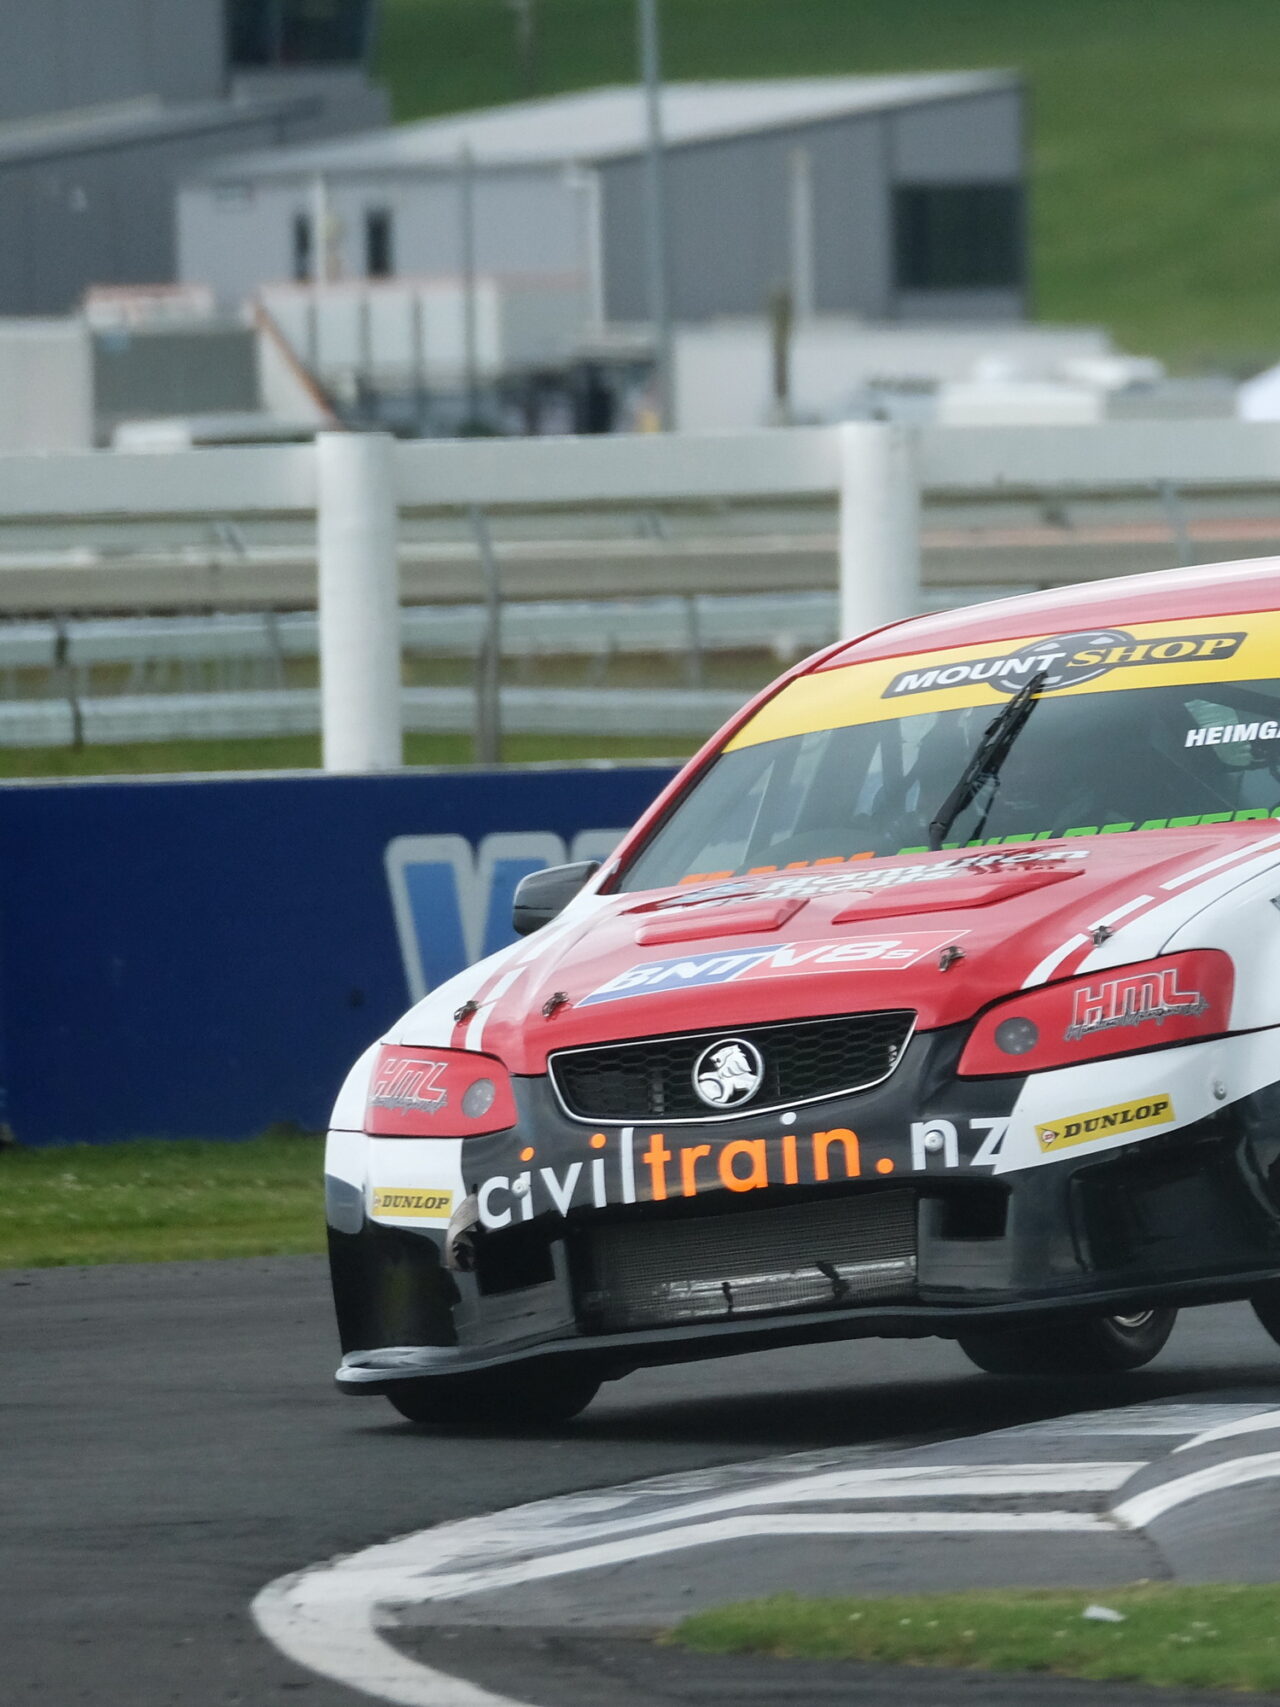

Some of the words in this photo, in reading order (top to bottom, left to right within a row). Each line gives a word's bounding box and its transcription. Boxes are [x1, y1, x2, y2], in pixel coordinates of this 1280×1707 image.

[893, 651, 1067, 693] MOUNT
[1065, 637, 1238, 668] SHOP
[597, 952, 765, 994] BNT
[769, 940, 919, 969] V8s
[1062, 1101, 1170, 1139] DUNLOP
[476, 1112, 1013, 1230] civiltrain.nz
[381, 1194, 450, 1210] DUNLOP
